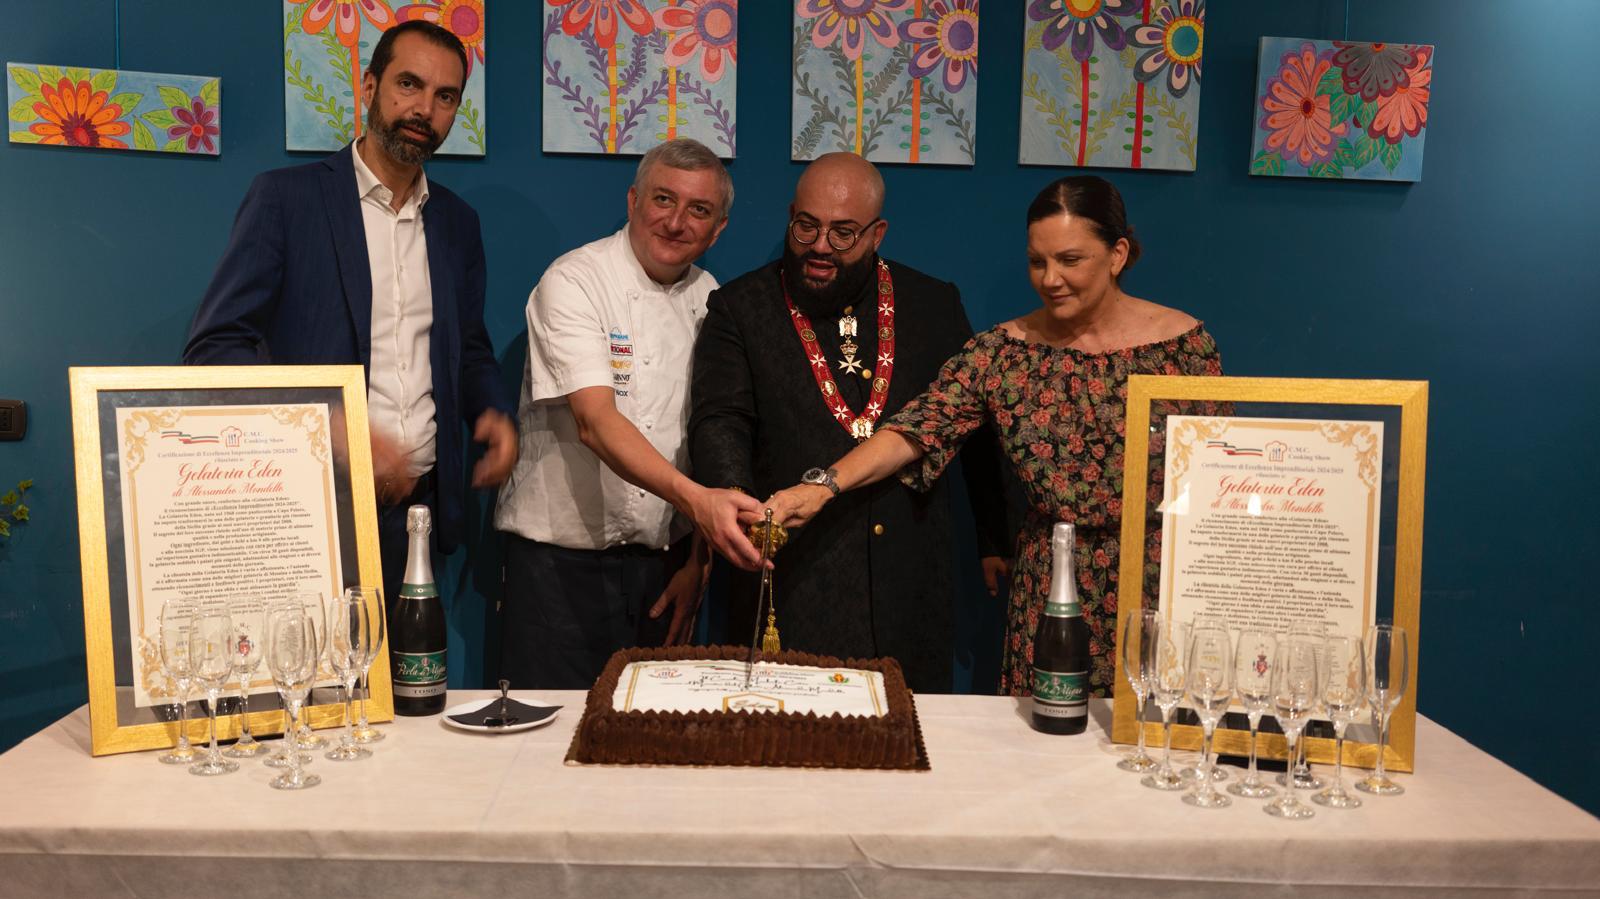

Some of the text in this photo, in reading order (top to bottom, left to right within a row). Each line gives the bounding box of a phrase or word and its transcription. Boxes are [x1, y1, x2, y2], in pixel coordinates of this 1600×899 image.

[179, 459, 282, 486] Gelateria Eden
[1274, 465, 1316, 474] Imprenditoriale
[172, 482, 283, 497] di Alessandro Mondello
[1218, 474, 1324, 496] Gelateria Eden
[1210, 498, 1221, 508] di
[1278, 499, 1324, 513] Mondello
